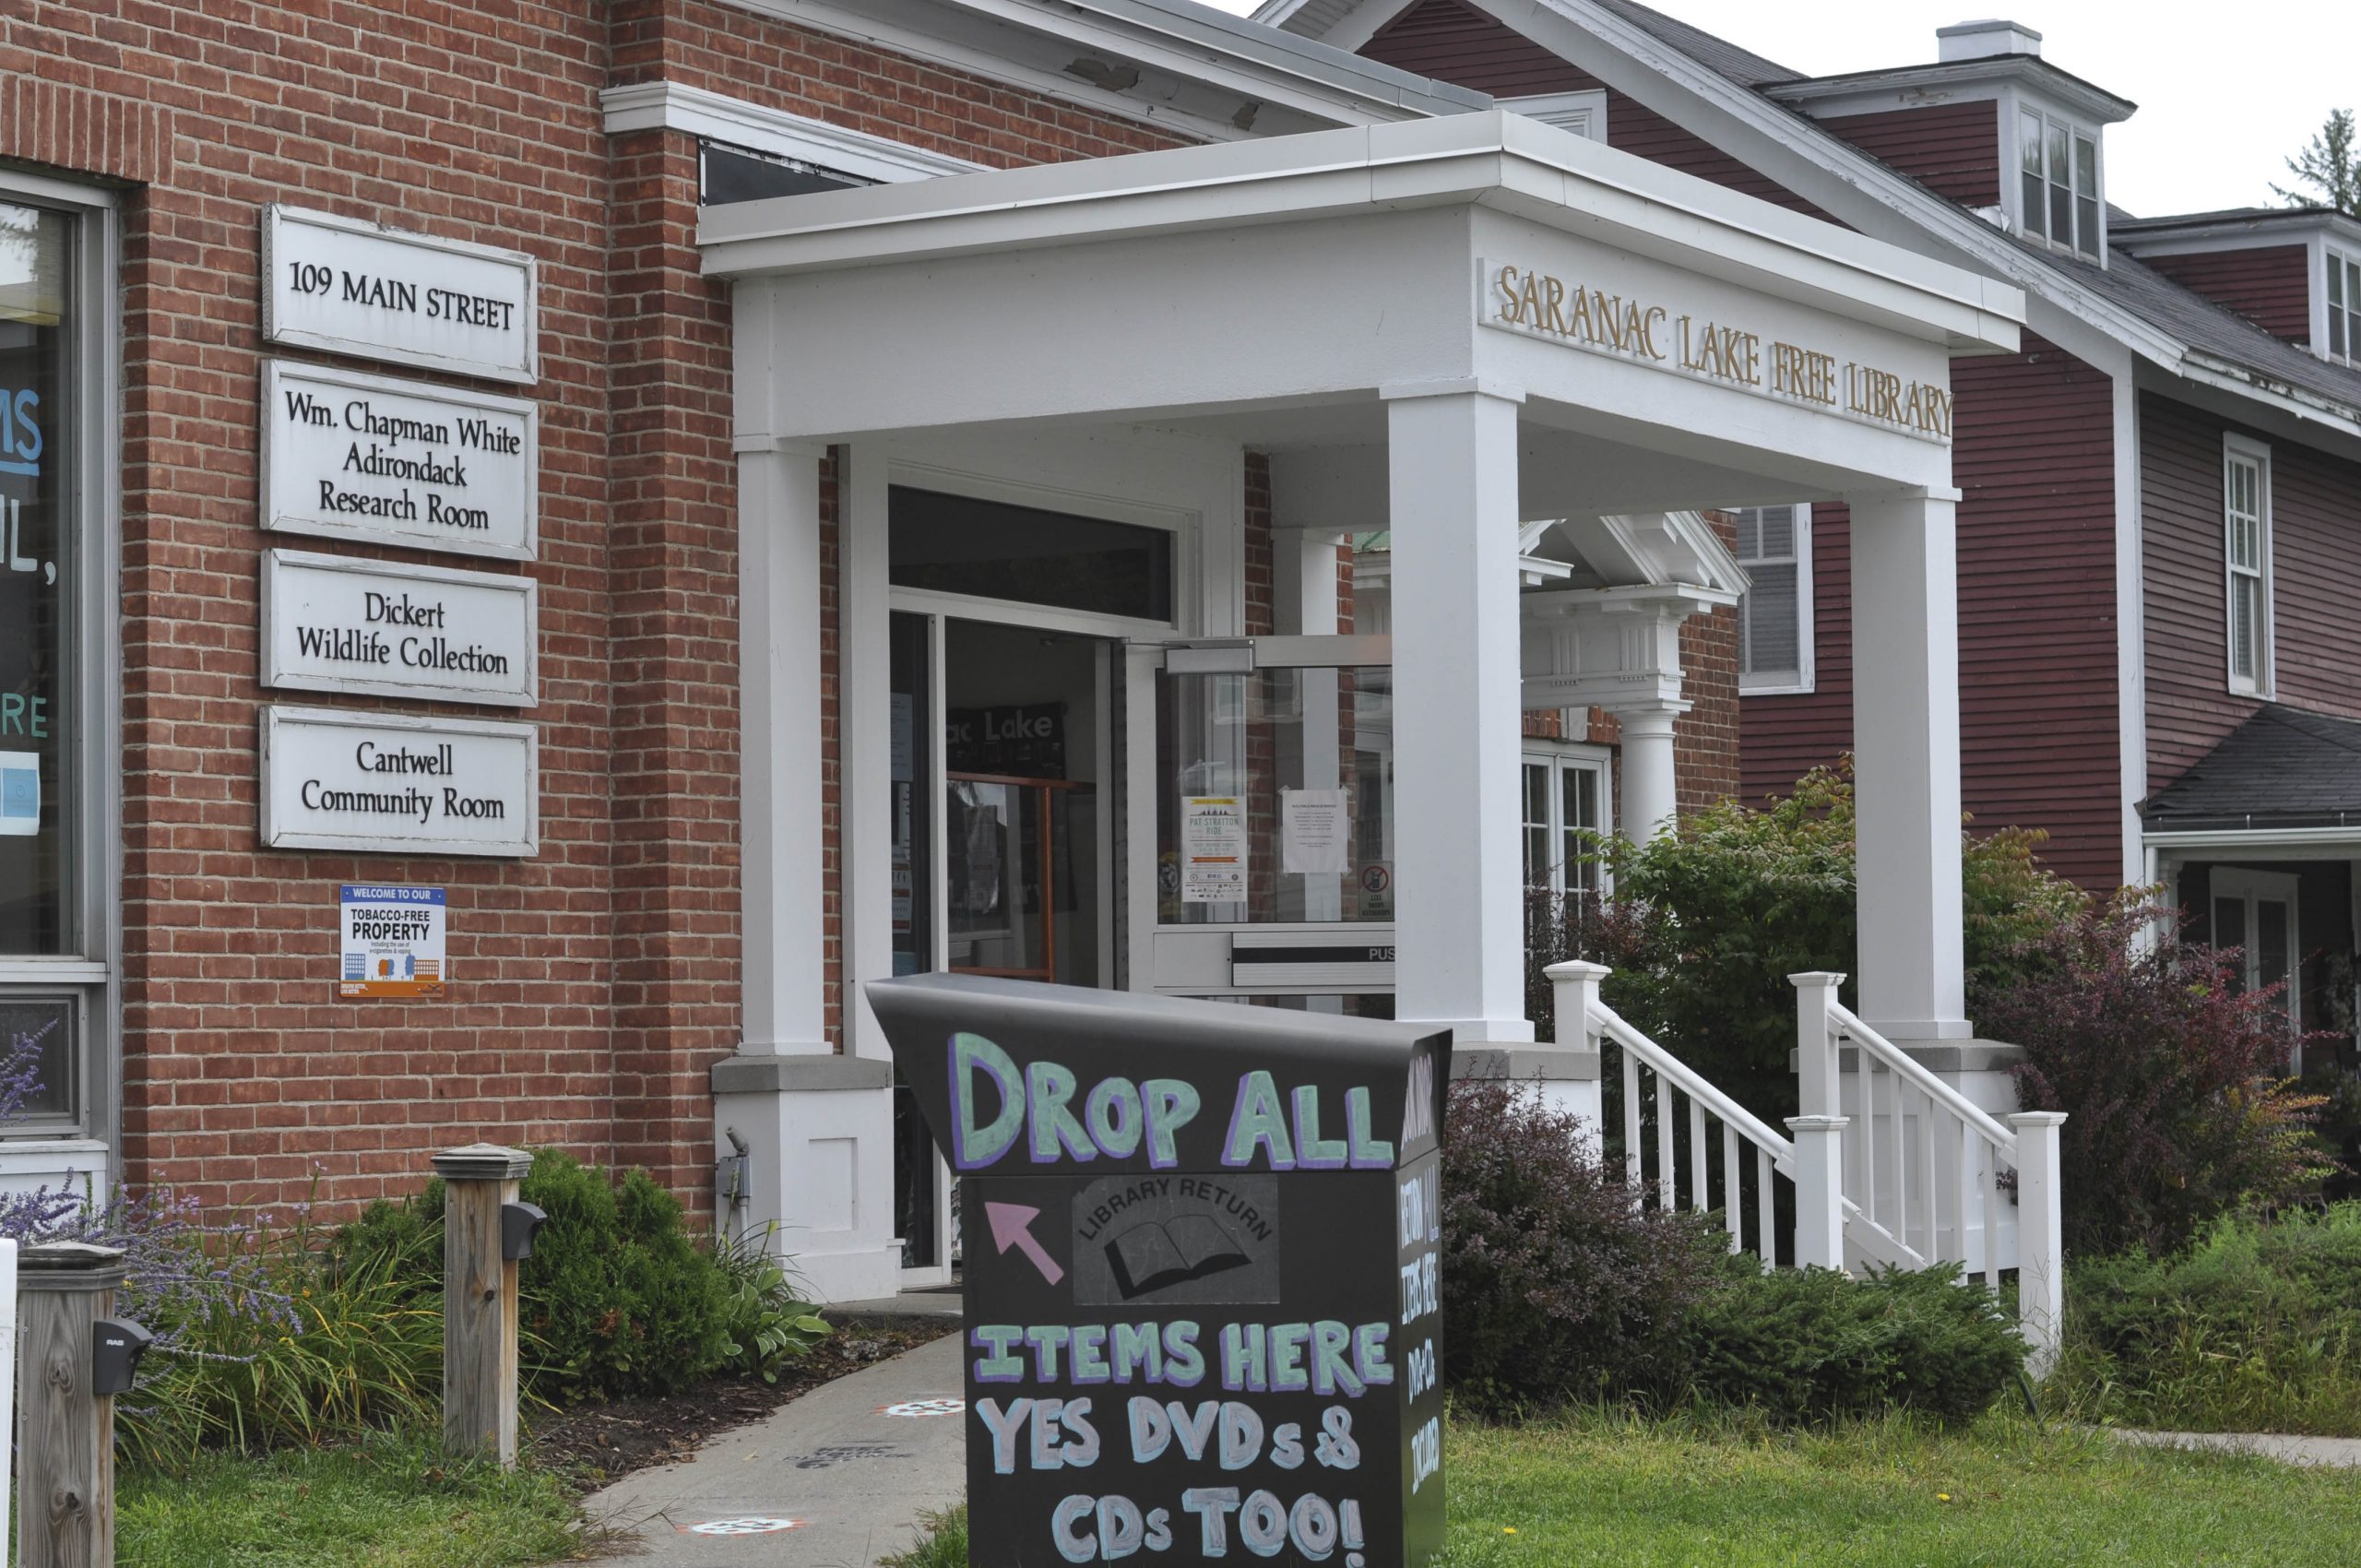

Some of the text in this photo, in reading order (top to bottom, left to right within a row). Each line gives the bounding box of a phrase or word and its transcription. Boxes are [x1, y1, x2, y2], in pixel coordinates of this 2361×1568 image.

[289, 261, 515, 330] 109 MAIN STREET
[1501, 265, 1955, 437] SARANAC LAKE FREE LIBRARY
[285, 390, 521, 455] Wm. Chapman White
[342, 441, 468, 487] Adirondack
[319, 480, 490, 529] Research Room
[364, 591, 445, 628] Dickert
[296, 626, 509, 674] Wildlife Collection
[2, 693, 48, 738] RE
[984, 708, 1054, 741] Lake
[356, 741, 454, 775] Cantwell
[301, 779, 504, 824] Community Room
[1189, 818, 1240, 826] PAT STRATTON
[1205, 826, 1223, 835] RIDE
[350, 909, 431, 921] TOBACCO-FREE
[352, 887, 432, 900] WELCOME TO OUR
[352, 922, 430, 941] PROPERTY
[947, 1031, 1201, 1170] DROP
[1220, 1070, 1394, 1171] ALL
[1078, 1178, 1273, 1242] LIBRARY RETURN
[1401, 1252, 1438, 1325] ITEMS HERE
[970, 1320, 1394, 1398] ITEMS HERE
[975, 1396, 1360, 1474] YES DVDs &
[1051, 1486, 1365, 1568] CDs TOO!
